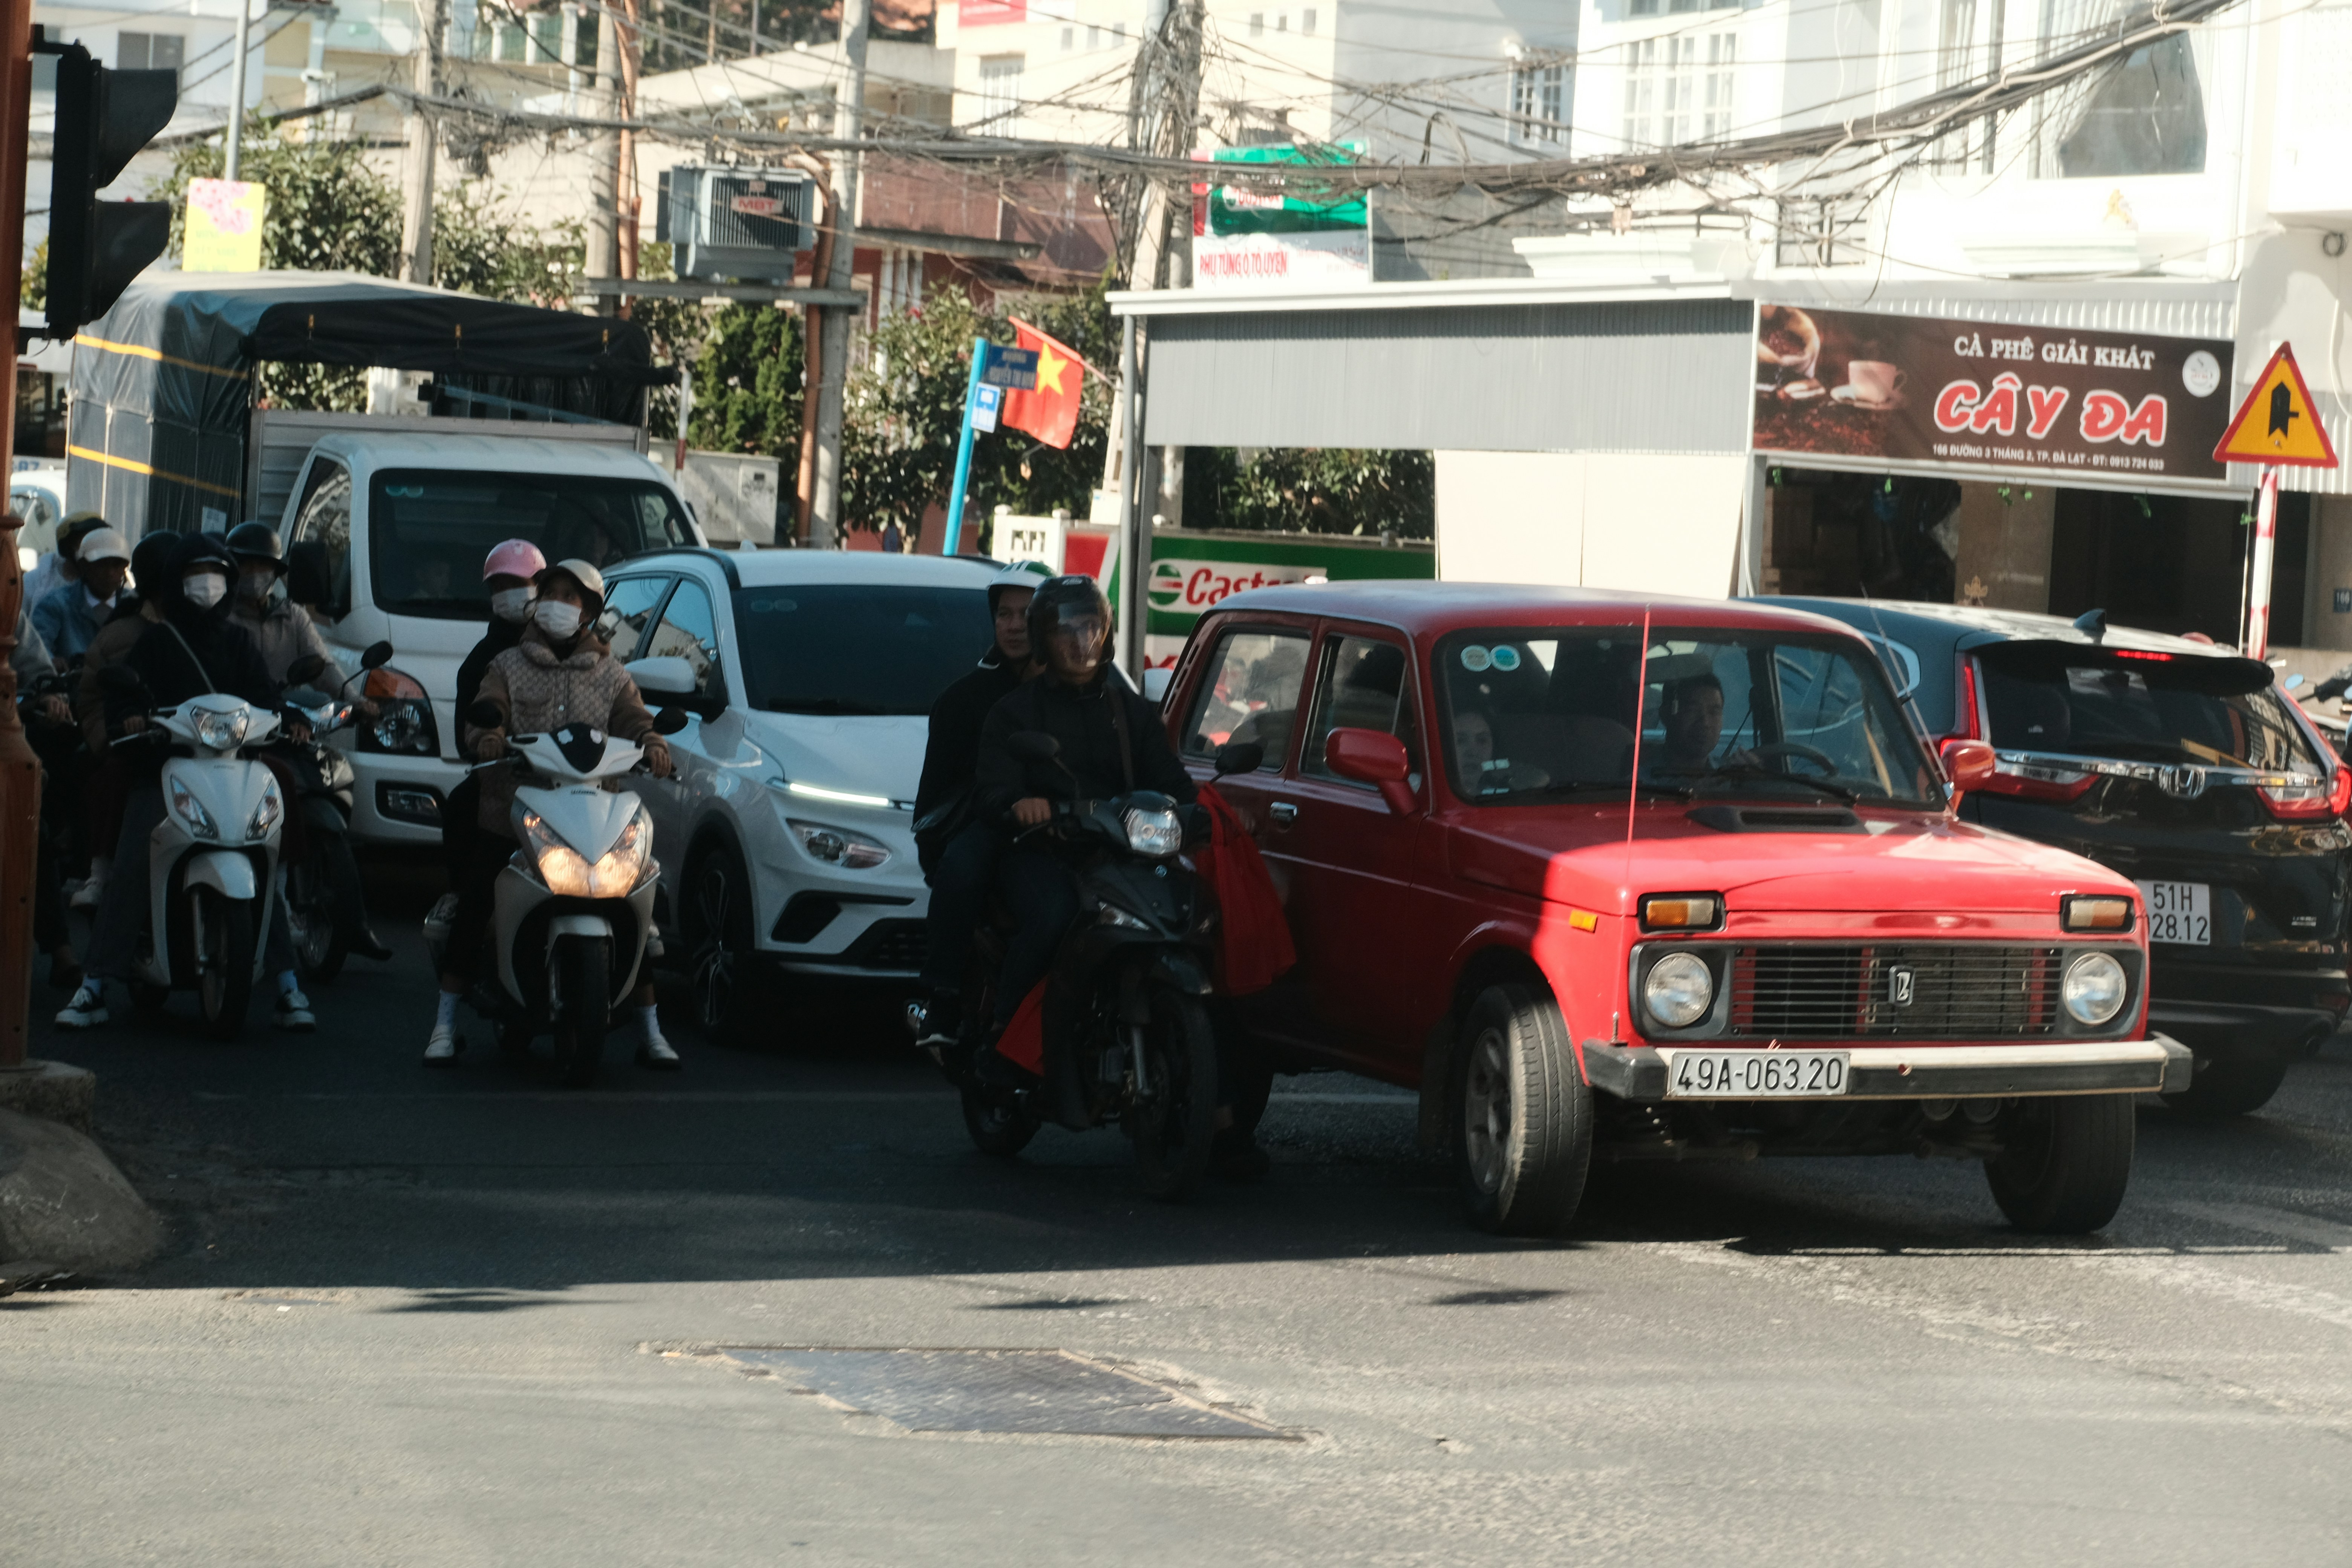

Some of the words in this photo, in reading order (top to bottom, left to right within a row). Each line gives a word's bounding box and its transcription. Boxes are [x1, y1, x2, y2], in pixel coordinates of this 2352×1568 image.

[738, 199, 776, 211] MBT
[1954, 332, 1984, 358] CÀ
[1990, 335, 2035, 361] PHÊ
[2041, 337, 2088, 365] GIẢI
[2093, 344, 2155, 371] KHÁT
[1934, 371, 2070, 440] CÂY
[2079, 389, 2168, 447] ĐA
[1985, 446, 1991, 459] 3
[1993, 445, 2024, 461] THÁNG
[2037, 449, 2050, 463] TP.
[2053, 450, 2066, 464] ĐÀ
[2068, 452, 2086, 466] LẠT
[2153, 883, 2193, 912] 51H
[2148, 913, 2208, 942] 28.12
[1677, 1058, 1842, 1091] 49A-063.20
